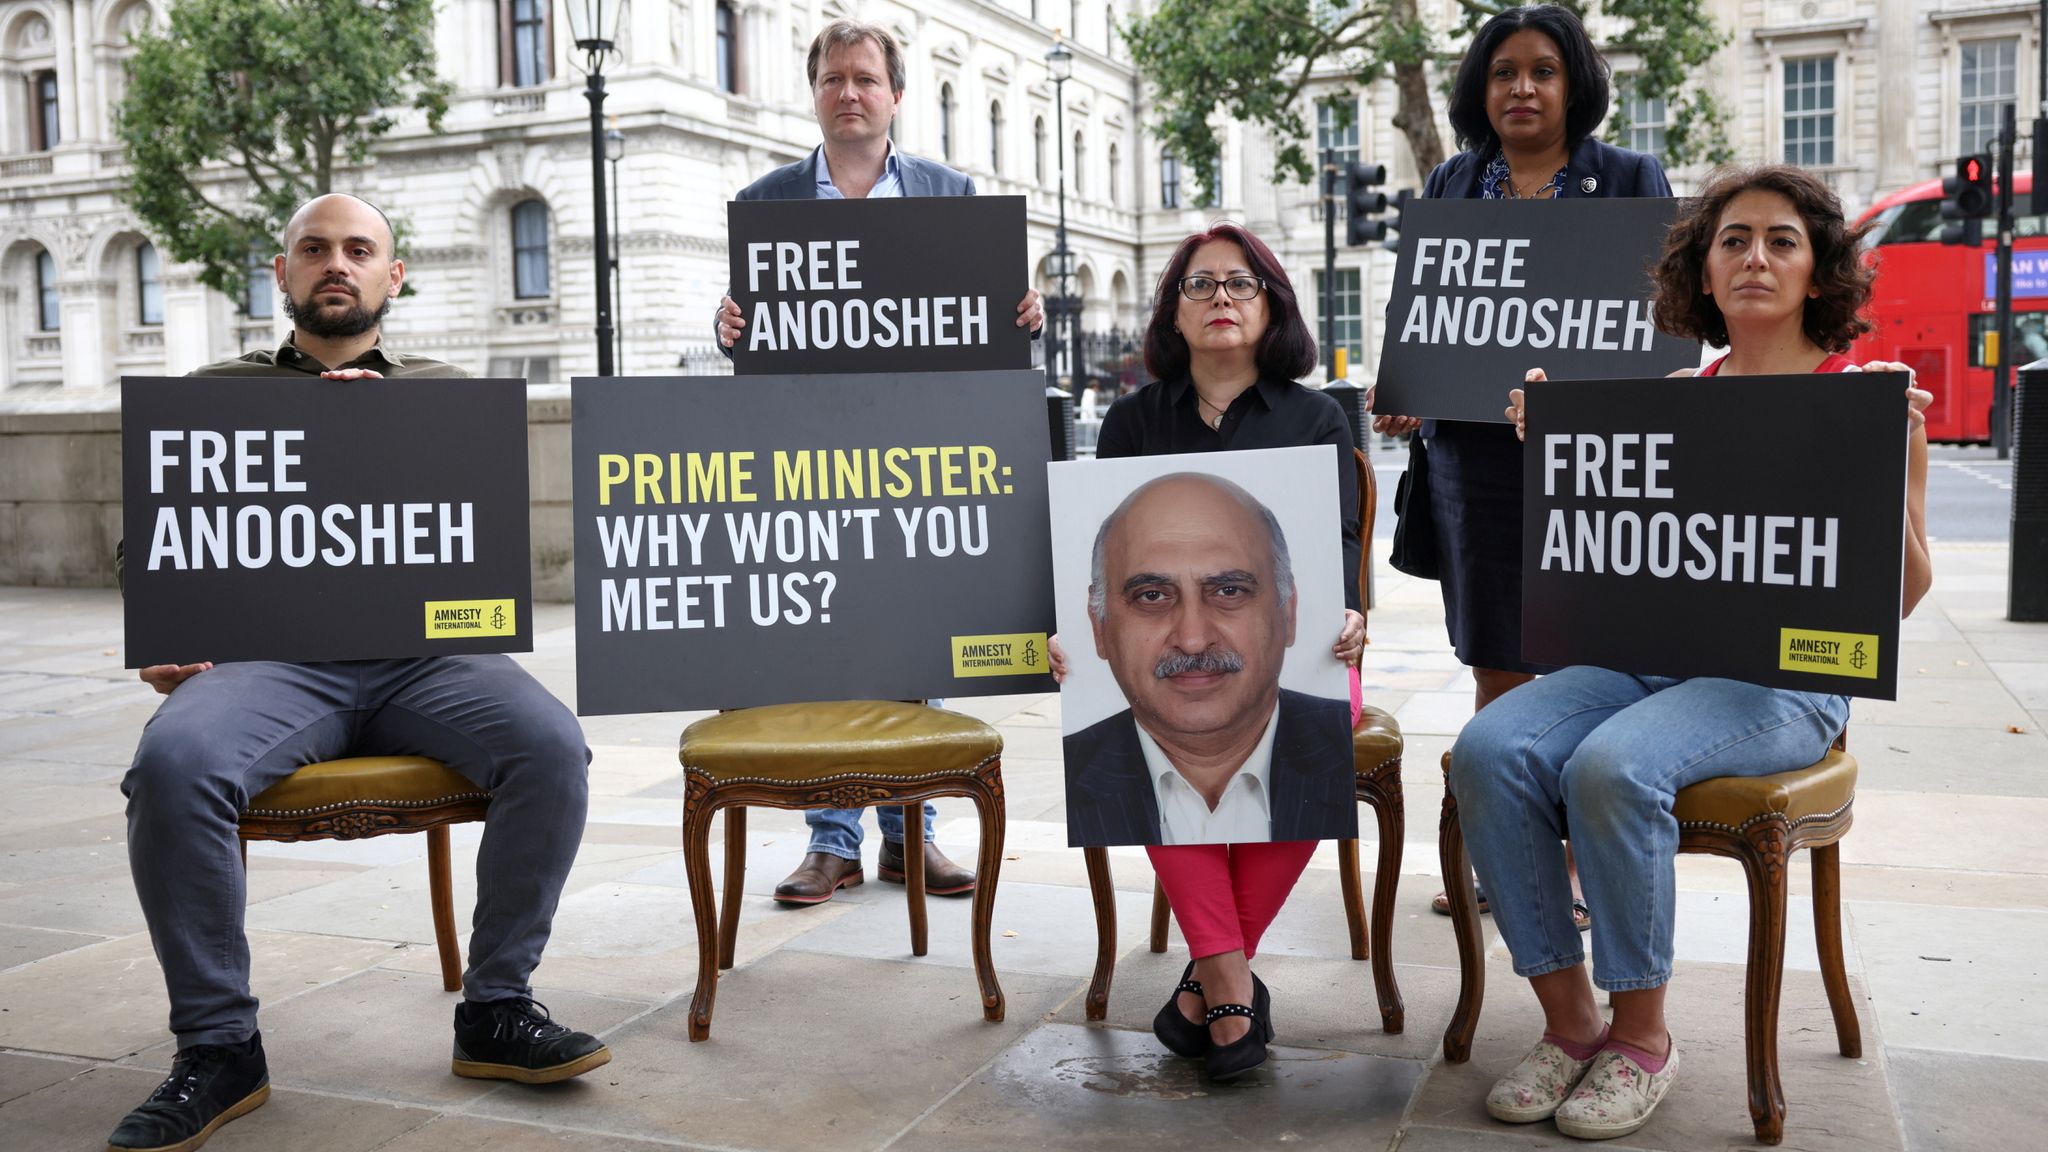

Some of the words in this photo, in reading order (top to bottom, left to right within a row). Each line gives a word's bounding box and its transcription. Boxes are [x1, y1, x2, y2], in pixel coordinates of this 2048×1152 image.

[747, 240, 863, 292] FREE
[1411, 237, 1531, 288] FREE
[748, 295, 989, 352] ANOOSHEH
[1399, 295, 1656, 352] ANOOSHEH
[150, 430, 307, 494] FREE
[598, 449, 758, 506] PRIME
[773, 445, 1014, 503] MINISTER:
[1544, 433, 1674, 499] FREE
[147, 502, 475, 571] ANOOSHEH
[595, 513, 711, 569] WHY
[723, 508, 881, 565] WON’T
[892, 504, 989, 559] YOU
[1540, 509, 1839, 588] ANOOSHEH
[434, 608, 482, 621] AMNESTY
[434, 621, 482, 630] INTERNATIONAL
[600, 574, 733, 633] MEET
[748, 570, 838, 627] US?
[961, 643, 1012, 658] AMNESTY
[962, 657, 1014, 668] INTERNATIONAL
[1788, 652, 1840, 666] INTERNATIONAL
[1789, 638, 1841, 655] AMNESTY
